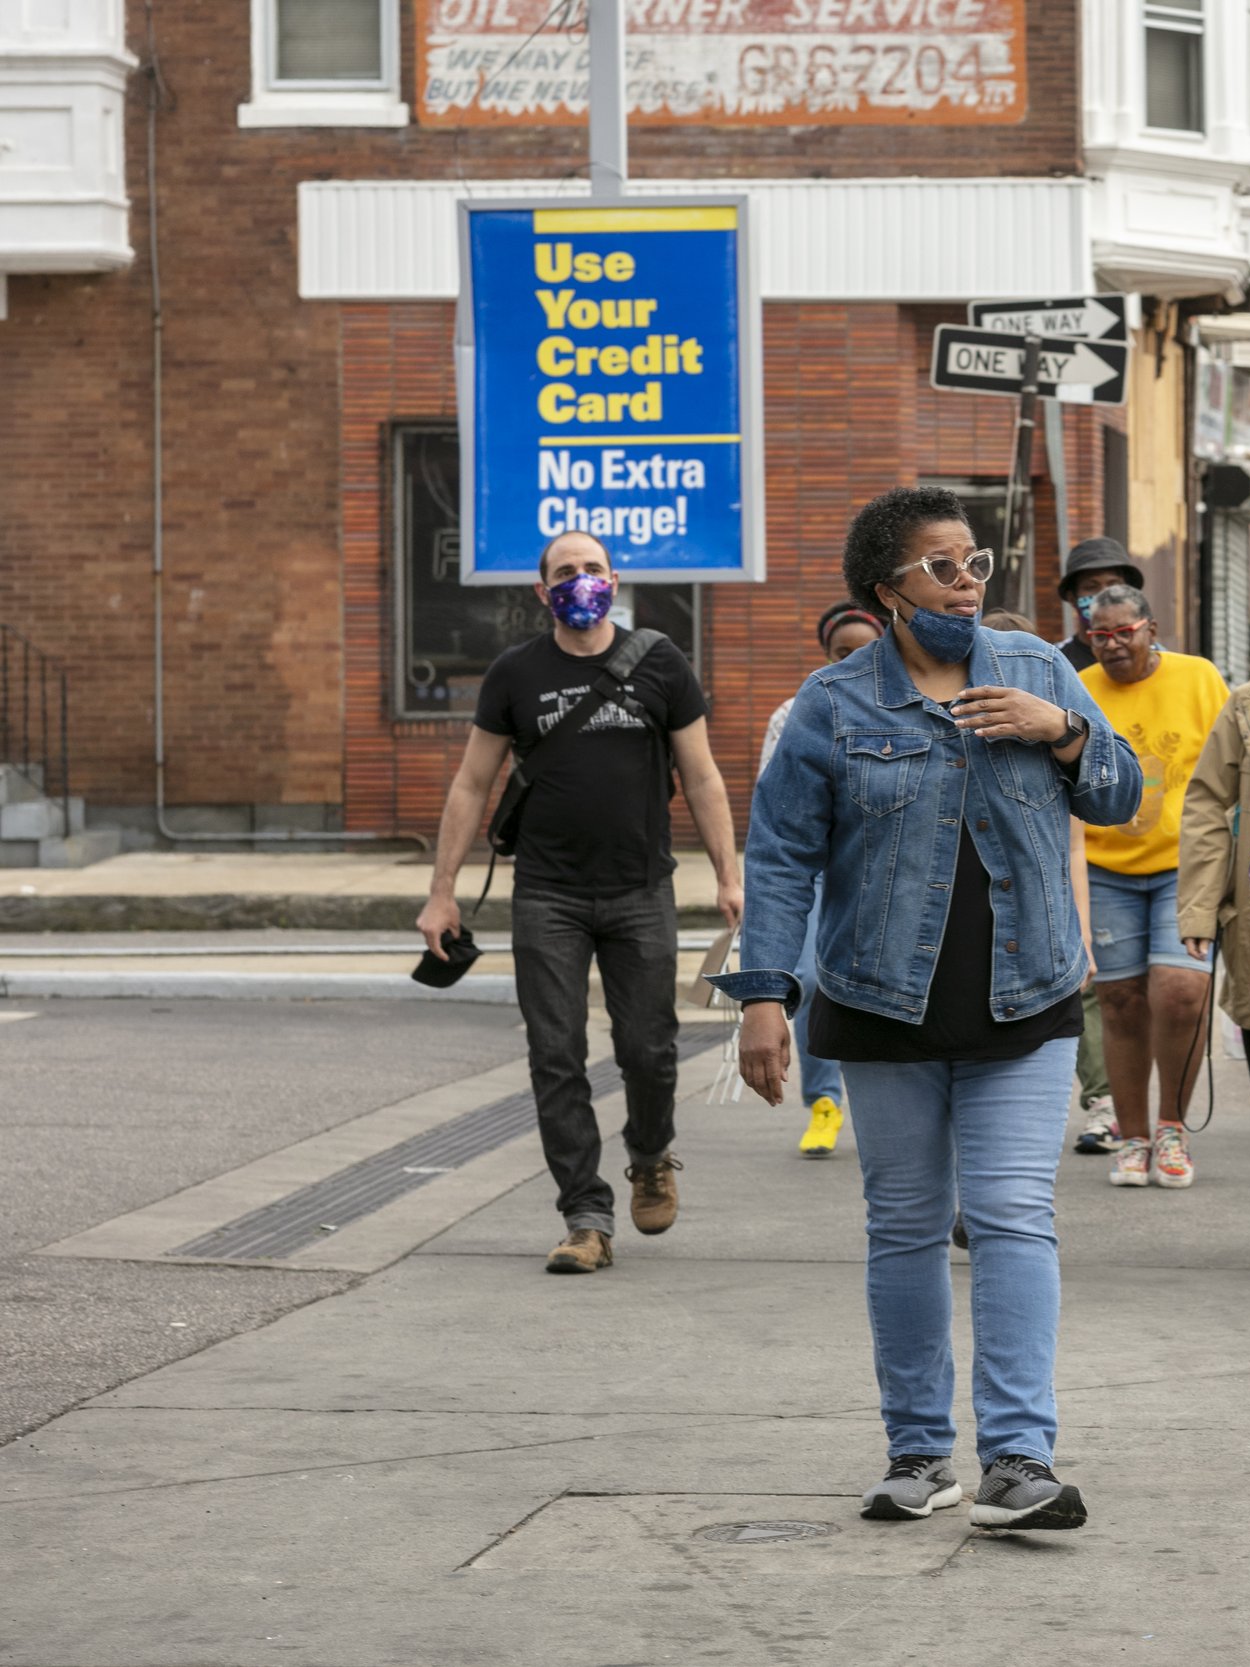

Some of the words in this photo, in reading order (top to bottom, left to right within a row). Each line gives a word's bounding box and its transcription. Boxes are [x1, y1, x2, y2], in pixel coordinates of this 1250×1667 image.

[440, 0, 519, 27] OIL
[783, 0, 986, 27] SERVICE
[534, 242, 636, 283] Use
[535, 289, 658, 329] Your
[991, 315, 1035, 333] ONE
[1041, 312, 1085, 331] WAY
[536, 334, 703, 377] Credit
[956, 347, 1007, 375] ONE
[1018, 354, 1069, 380] AY
[537, 381, 663, 424] Card
[538, 450, 595, 490] No
[601, 449, 705, 490] Extra
[537, 496, 688, 545] Charge!
